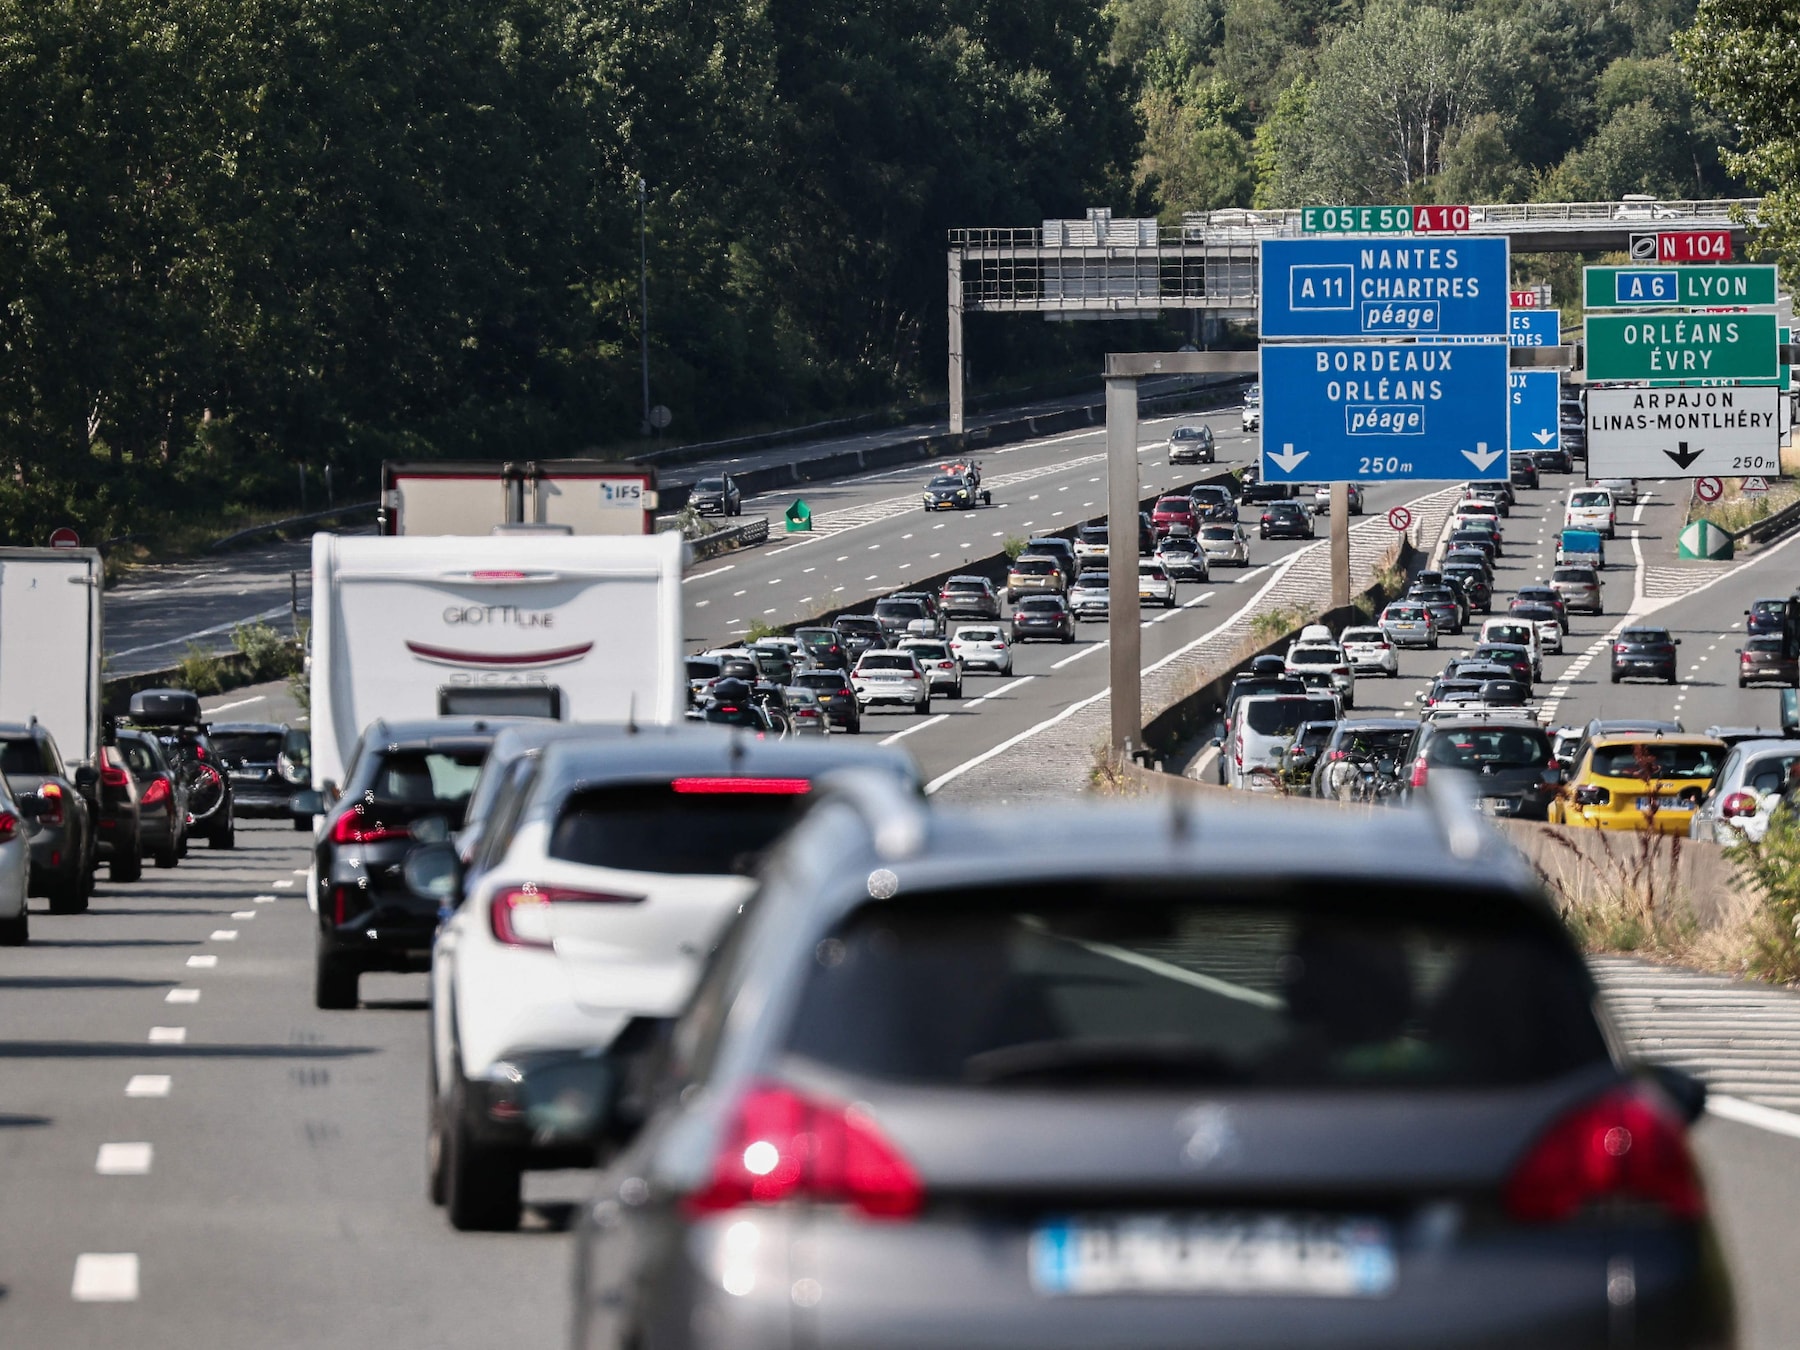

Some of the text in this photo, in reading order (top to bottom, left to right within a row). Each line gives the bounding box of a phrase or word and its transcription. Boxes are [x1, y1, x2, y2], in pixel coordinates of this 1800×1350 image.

[1304, 209, 1355, 230] E 05
[1359, 209, 1410, 230] E 50
[1416, 208, 1466, 230] A 10
[1662, 235, 1726, 258] N 104
[1360, 248, 1459, 270] NANTES
[1300, 277, 1344, 299] A 11
[1360, 278, 1480, 299] CHARTRES
[1629, 277, 1666, 298] A 6
[1687, 276, 1748, 297] LYON
[1366, 303, 1435, 329] péage
[1623, 319, 1740, 345] ORLÉANS
[1315, 350, 1453, 373] BORDEAUX
[1649, 349, 1713, 372] ÉVRY
[1326, 376, 1443, 401] ORLÉANS
[1633, 391, 1734, 409] ARPAJON
[1351, 409, 1420, 433] péage
[1592, 409, 1774, 431] LINAS-MONTLHÉRY
[615, 485, 641, 499] IFS
